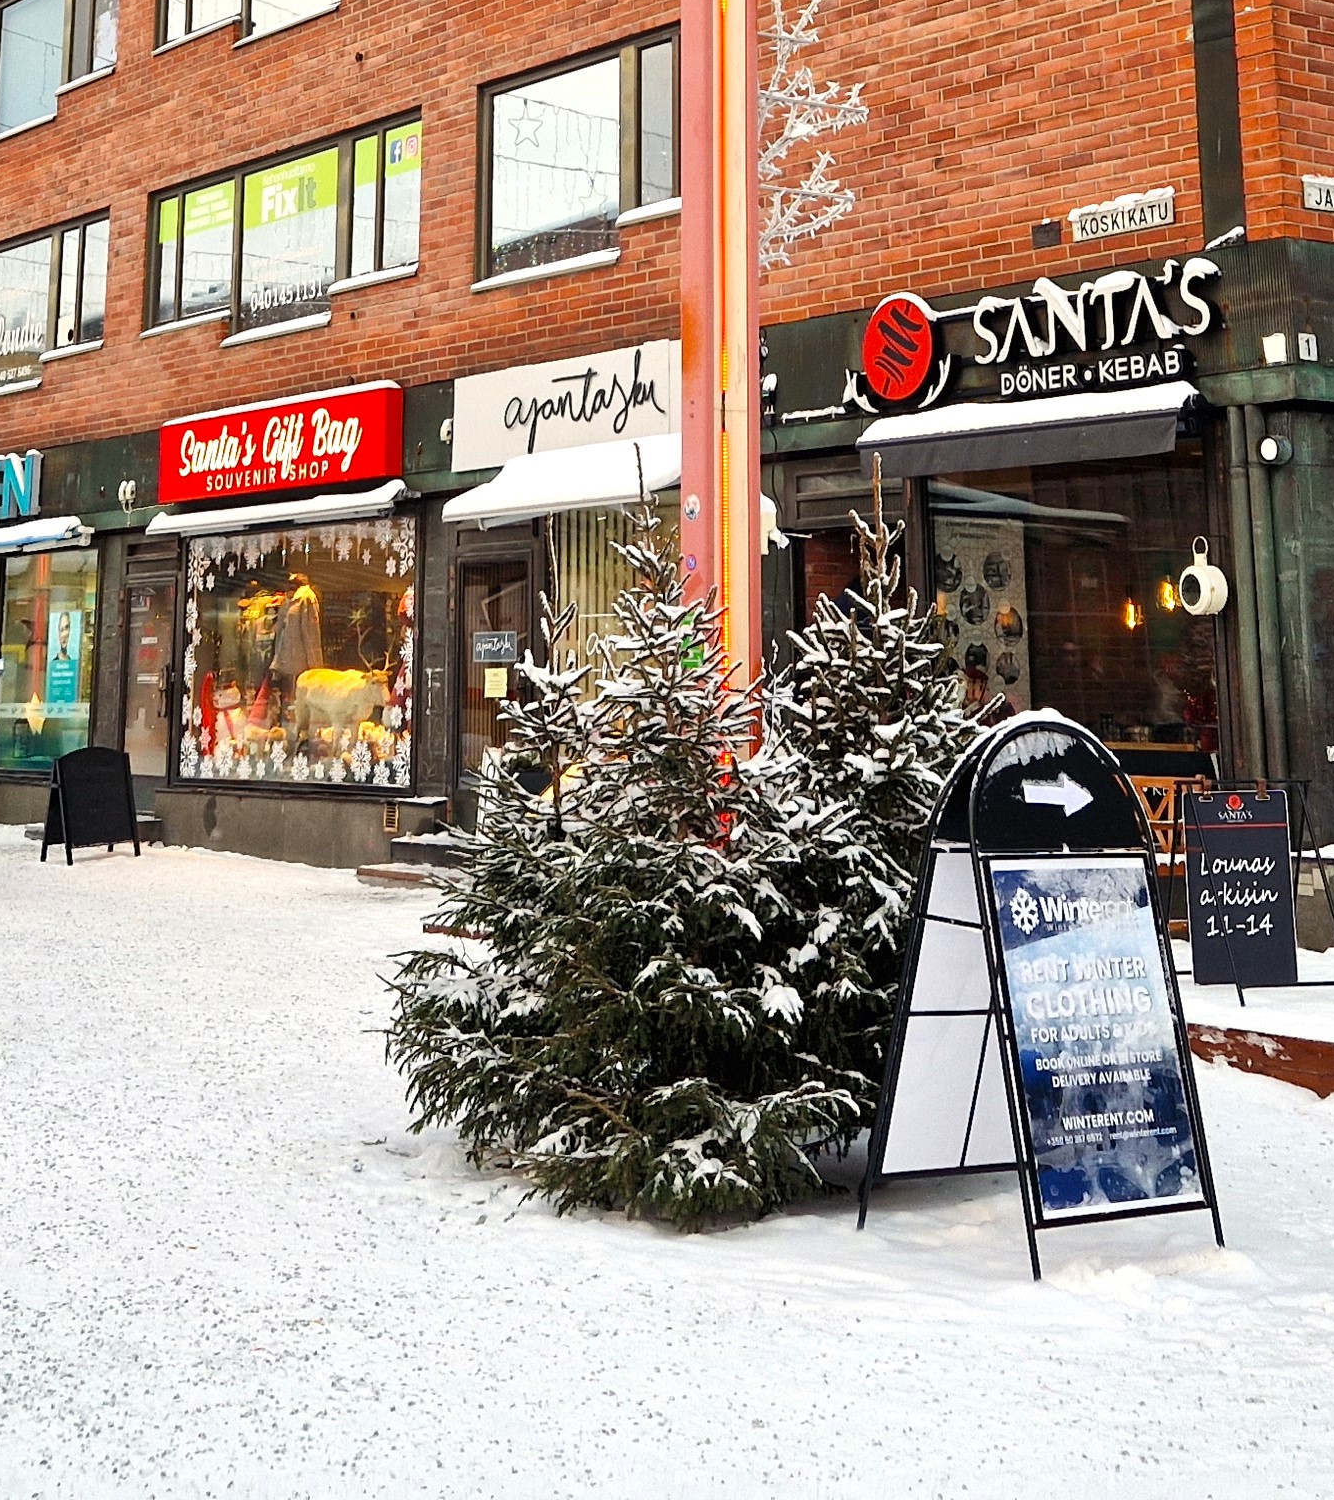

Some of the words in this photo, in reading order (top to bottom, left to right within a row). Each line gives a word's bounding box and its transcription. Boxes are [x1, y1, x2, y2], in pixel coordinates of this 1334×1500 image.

[261, 177, 317, 222] FixIt
[1079, 202, 1169, 237] KOSKIKATU
[973, 260, 1213, 366] SANTA'S
[1304, 338, 1313, 357] 1
[1000, 365, 1076, 395] DÖNER
[1098, 351, 1181, 383] KEBAB
[179, 420, 256, 476] Santa's
[262, 403, 304, 480] Gift
[311, 408, 363, 472] Bag
[206, 467, 276, 491] SOUVENIR
[289, 460, 329, 481] SHOP
[1218, 810, 1253, 820] SANTA'S
[1200, 852, 1276, 876] Lounas
[1039, 893, 1136, 923] Winterent
[1021, 958, 1069, 983] RENT
[1072, 957, 1147, 982] WINTER
[1026, 986, 1151, 1020] CLOTHING
[1031, 1026, 1059, 1043] FOR
[1061, 1025, 1110, 1041] ADULTS
[1036, 1056, 1065, 1071] BOOK
[1067, 1054, 1100, 1070] ONLINE
[1130, 1050, 1163, 1064] STORE
[1052, 1071, 1097, 1088] DELIVERY
[1099, 1068, 1152, 1085] AVAILABLE
[1062, 1108, 1155, 1131] WINTERENT.COM
